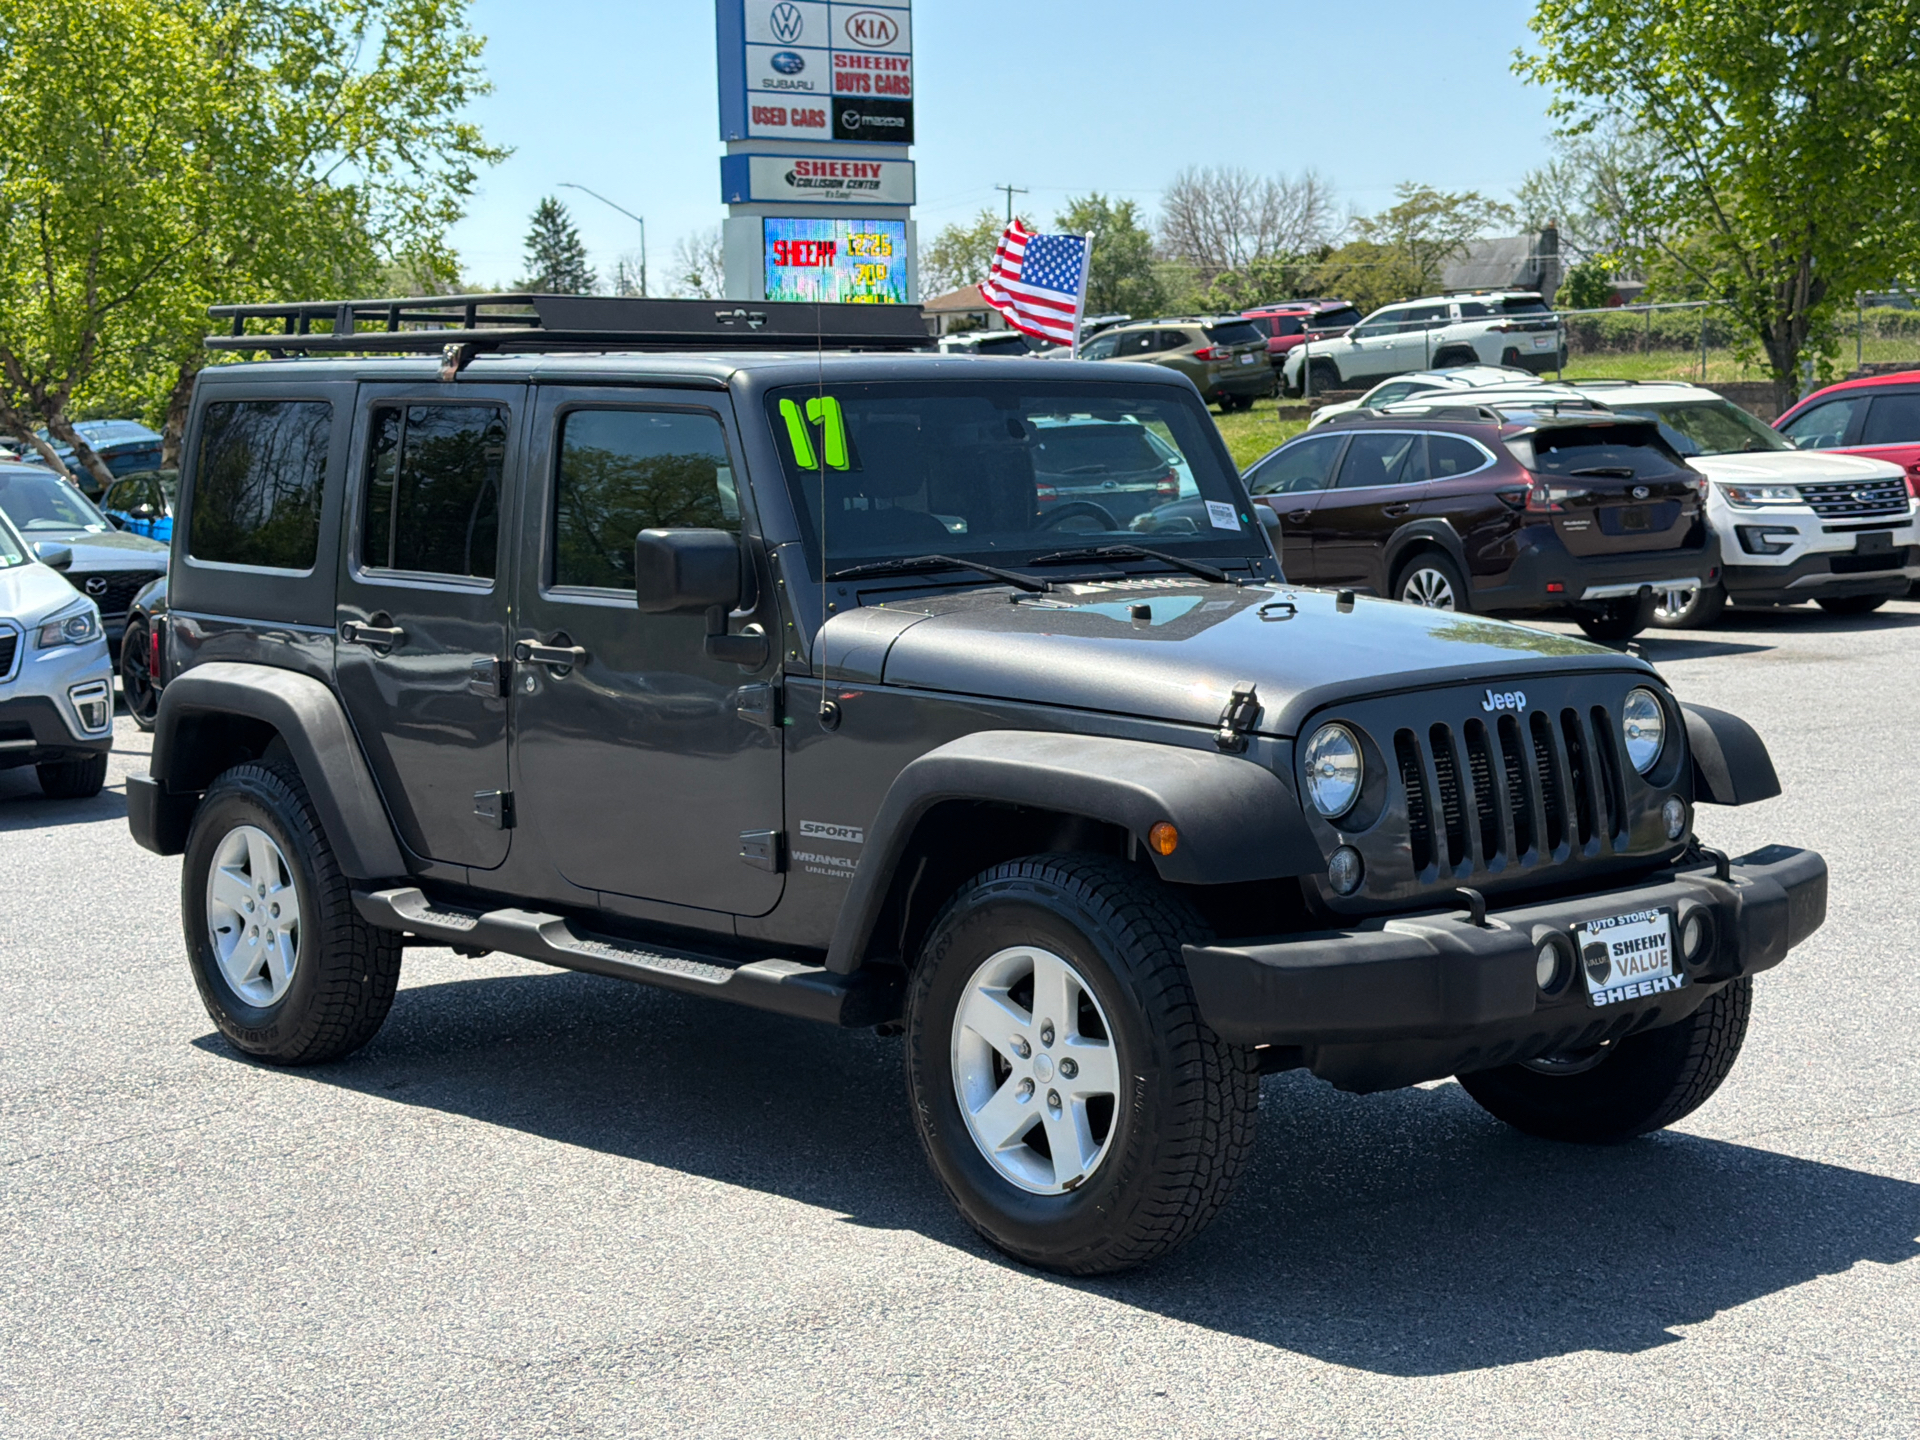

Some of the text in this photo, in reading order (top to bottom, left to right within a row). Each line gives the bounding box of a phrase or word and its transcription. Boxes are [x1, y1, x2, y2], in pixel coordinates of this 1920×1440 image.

[854, 18, 890, 40] KIA
[834, 54, 909, 72] SHEEHY
[762, 78, 815, 90] SUBARU
[835, 72, 910, 95] BUYS CARS
[752, 106, 826, 128] USED CARS
[861, 115, 905, 127] mazda
[795, 161, 882, 178] SHEEHY
[796, 177, 881, 190] COLLISION CENTER
[774, 240, 836, 267] SHEEHY
[779, 396, 849, 470] 17
[1482, 689, 1527, 712] Jeep
[802, 822, 863, 839] SPORT
[791, 850, 860, 868] WRANGL
[805, 865, 855, 879] UNLIMIT
[1586, 909, 1660, 932] AUTO STORES
[1612, 933, 1667, 957] SHEEHY
[1616, 949, 1668, 977] VALUE
[1592, 973, 1684, 1007] SHEEHY
